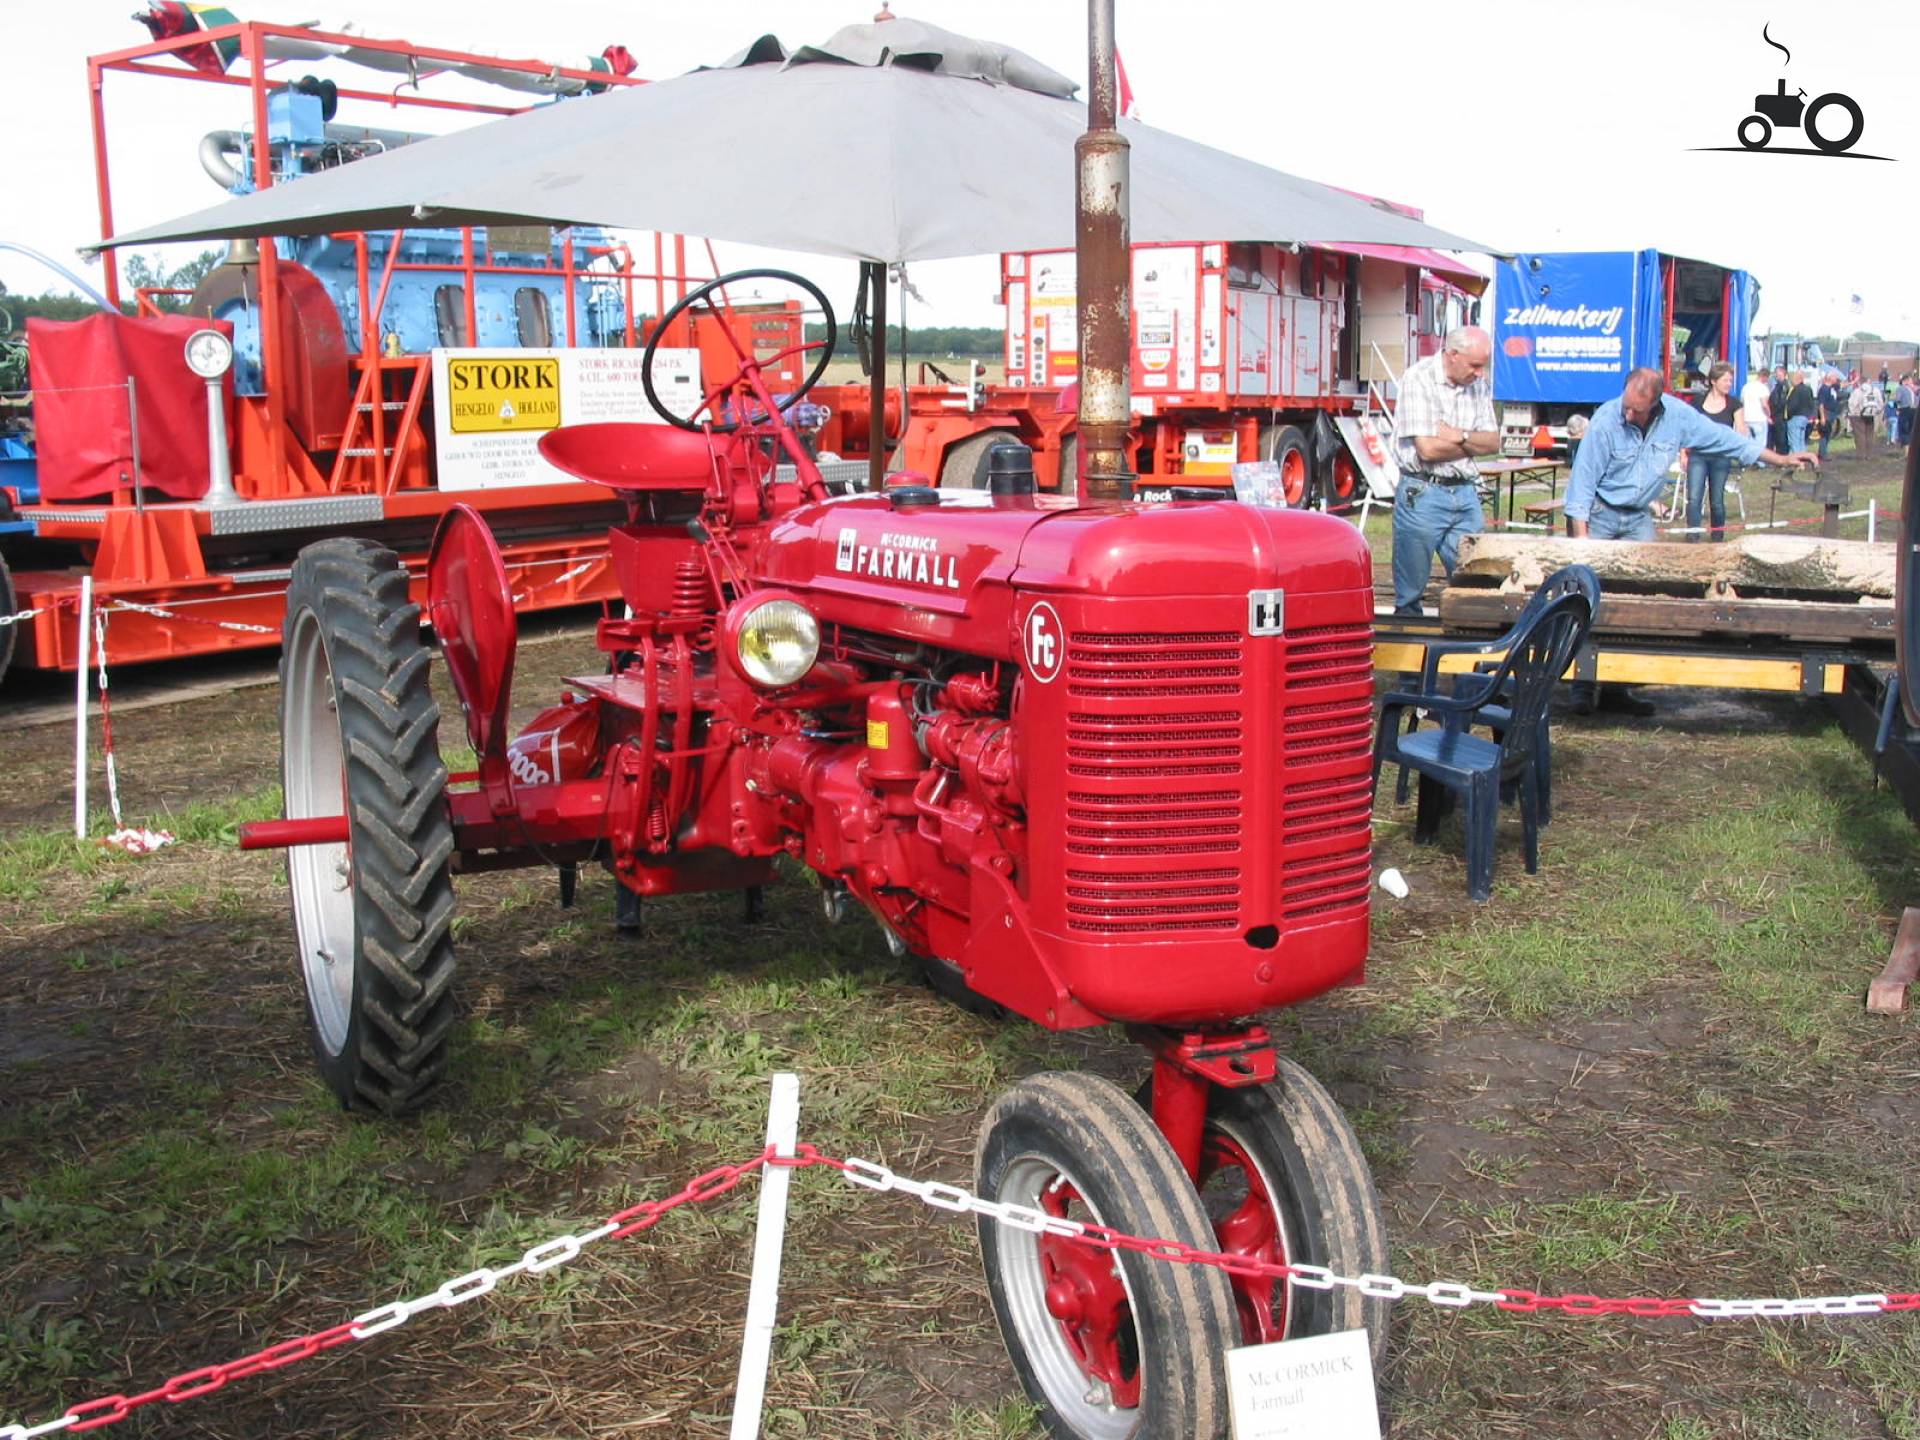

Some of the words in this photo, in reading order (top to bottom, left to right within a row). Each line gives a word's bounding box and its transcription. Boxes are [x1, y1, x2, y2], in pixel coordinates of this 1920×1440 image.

[1504, 304, 1623, 335] zeilmakerij
[579, 358, 609, 369] STORK
[454, 364, 554, 390] STORK
[455, 402, 495, 416] HENGELO
[518, 401, 557, 414] HOLLAND
[1144, 490, 1172, 503] Rock
[857, 545, 960, 588] FARMALL
[1275, 1355, 1354, 1382] CORMICK
[1250, 1386, 1305, 1412] Farmall
